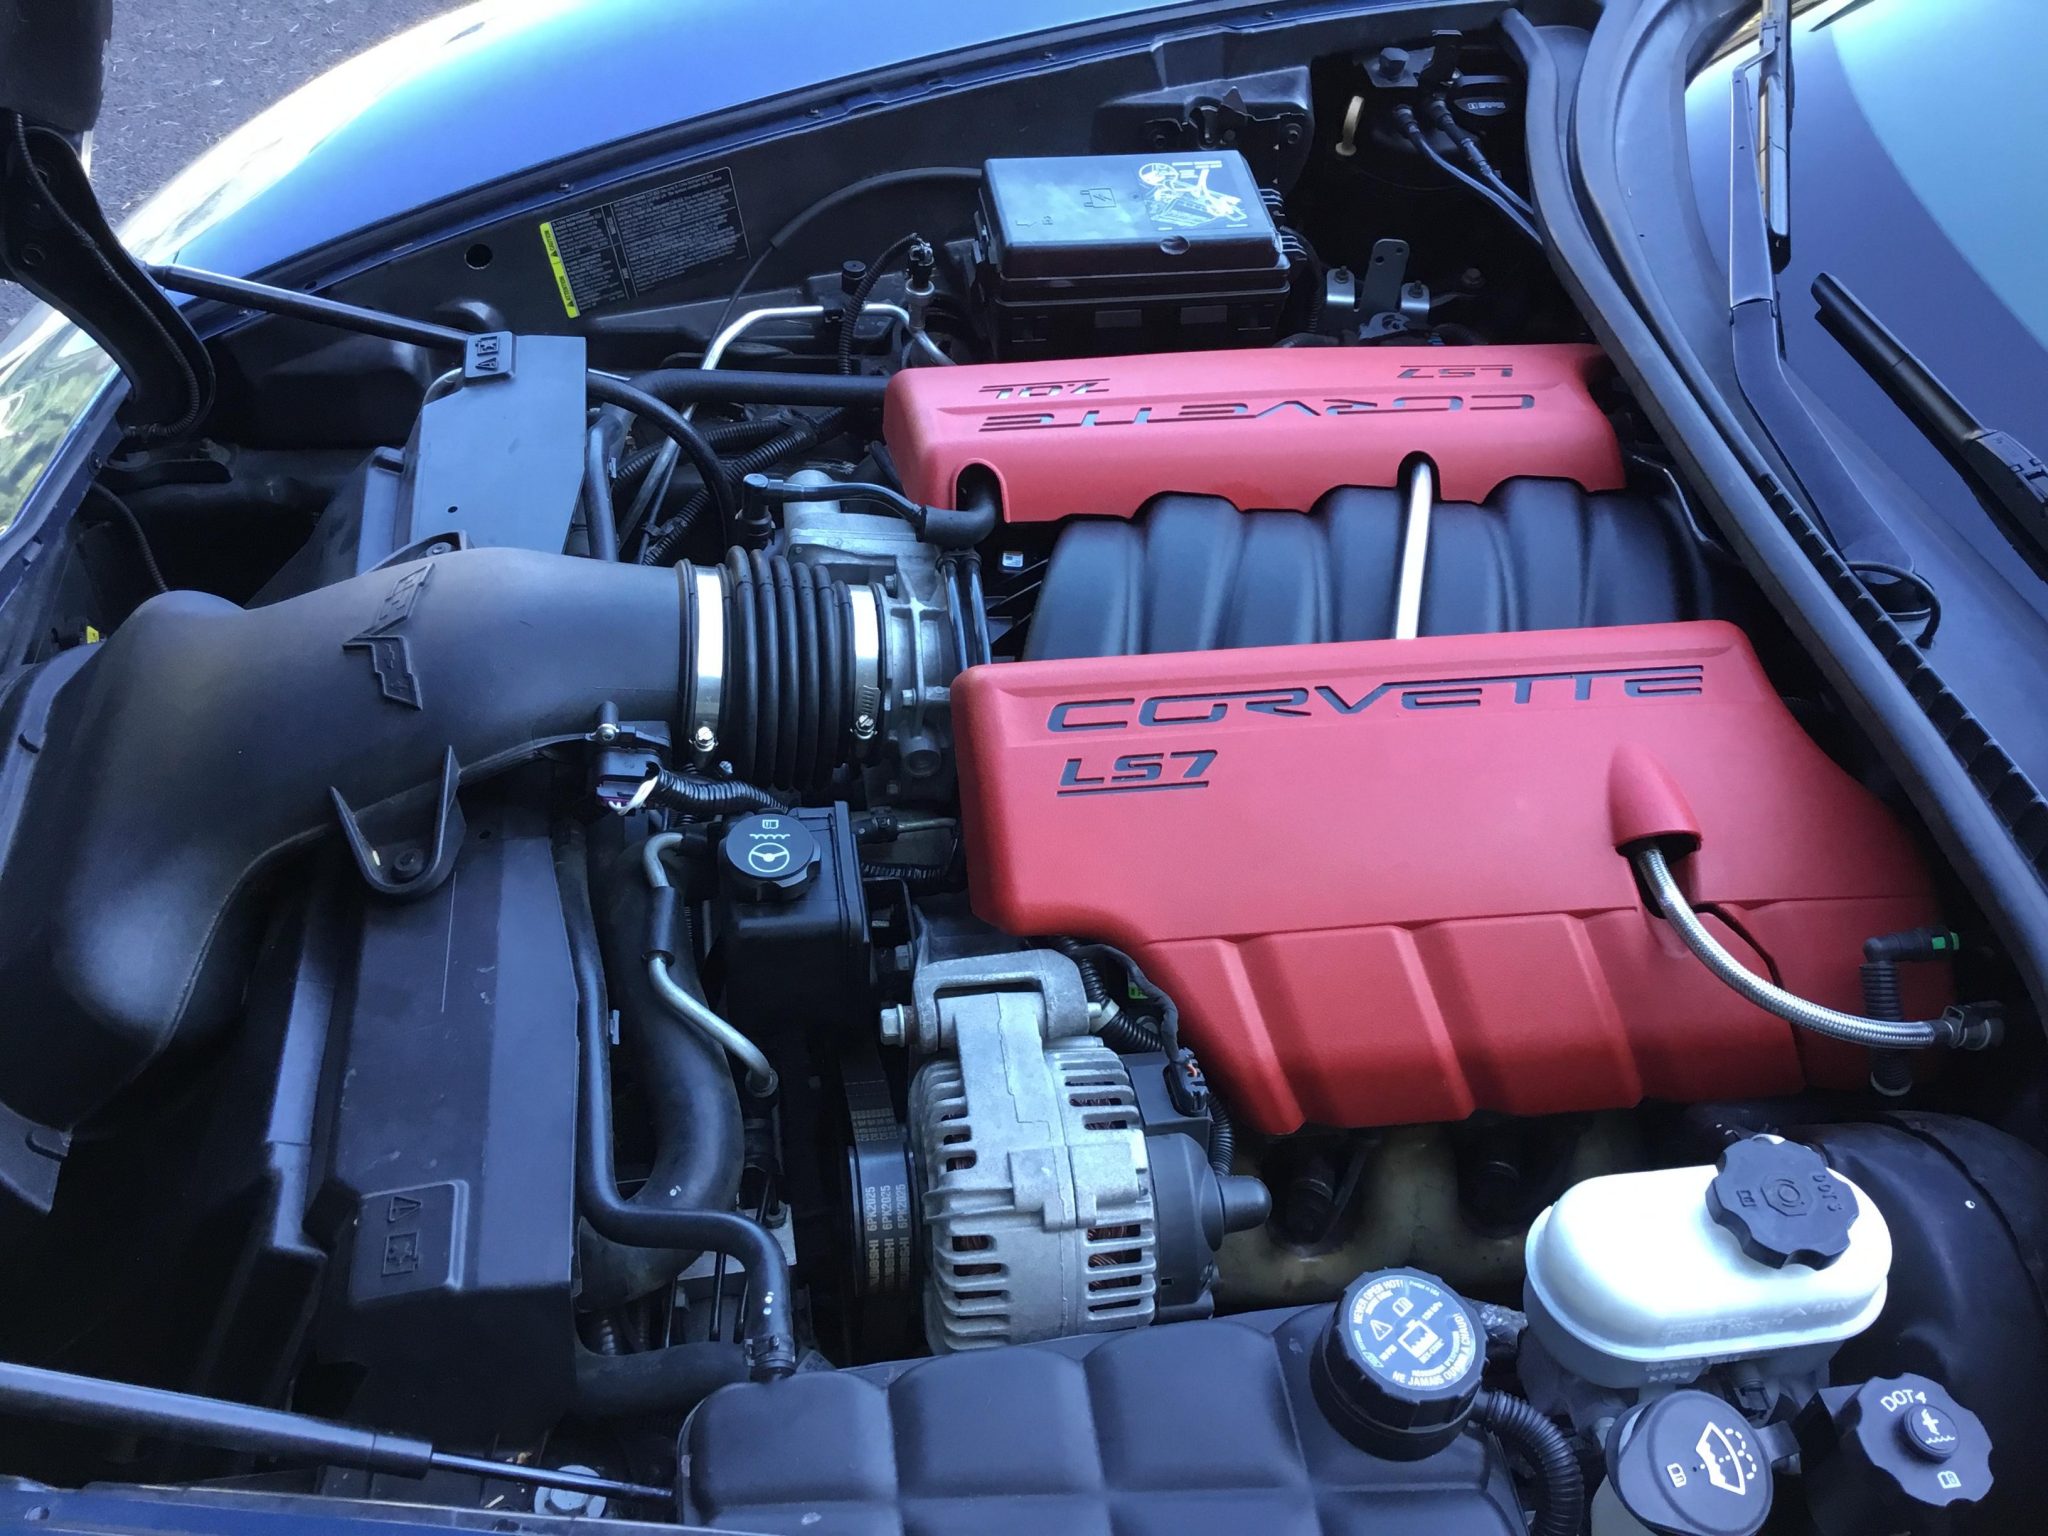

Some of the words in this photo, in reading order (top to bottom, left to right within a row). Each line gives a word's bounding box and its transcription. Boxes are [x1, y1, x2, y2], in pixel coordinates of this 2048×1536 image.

[1397, 366, 1513, 378] LS7
[979, 394, 1535, 432] CORVETTE
[1047, 665, 1703, 732] CORVETTE
[1059, 749, 1218, 788] LS7
[865, 1186, 878, 1232] 6PK2025
[880, 1184, 893, 1231] 6PK2025
[895, 1183, 909, 1229] 6PK2025
[1353, 1298, 1367, 1324] NEVER
[1364, 1283, 1384, 1299] OPEN
[1382, 1279, 1404, 1290] HOT!
[1392, 1370, 1406, 1383] NE
[1408, 1375, 1445, 1386] JAMAIS
[1452, 1312, 1471, 1346] CHAUD!
